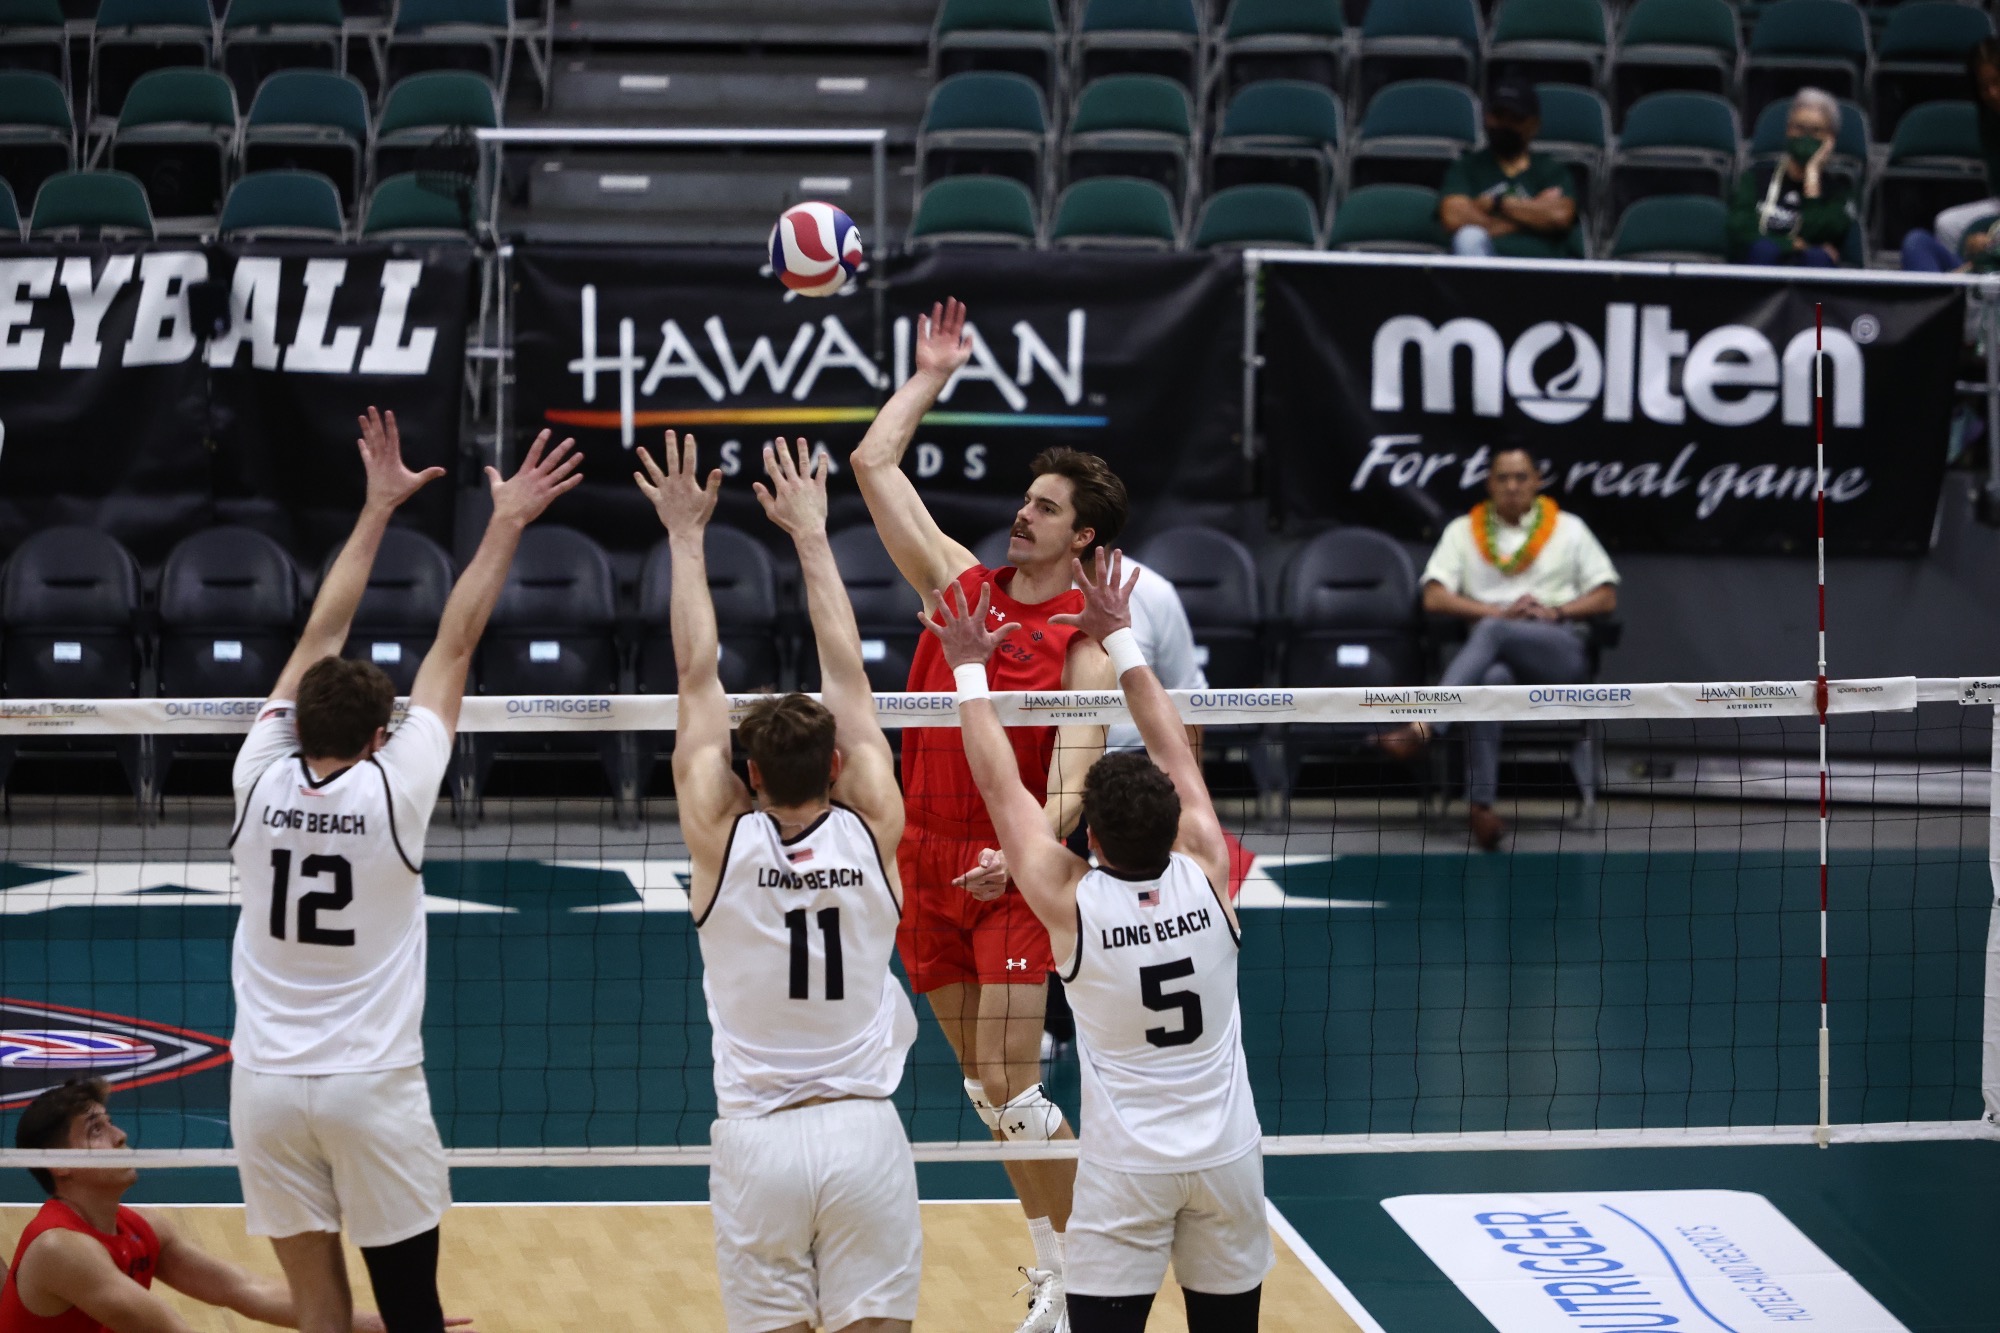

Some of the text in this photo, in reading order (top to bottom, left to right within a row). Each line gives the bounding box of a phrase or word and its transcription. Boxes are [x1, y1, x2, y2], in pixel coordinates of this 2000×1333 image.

[568, 284, 1086, 449] HAWAIAN
[1371, 303, 1865, 427] molten
[1351, 434, 1872, 520] For te real game
[506, 700, 611, 713] OUTRIGGER
[878, 697, 953, 710] TRIGGER
[1075, 695, 1123, 707] TOURISM
[1190, 694, 1294, 707] OUTRIGGER
[1414, 691, 1462, 703] TOURISM
[1529, 689, 1632, 702] OUTRIGGER
[1750, 686, 1797, 697] TOURISM
[262, 805, 366, 835] LONG BEACH
[804, 868, 863, 889] BEACH
[270, 848, 355, 946] 12
[1102, 908, 1211, 949] LONG BEACH
[785, 907, 844, 1001] 11
[1139, 957, 1203, 1048] 5
[1474, 1210, 1690, 1333] UTRIGGER
[1675, 1225, 1814, 1321] HOTELS AND RESORTS
